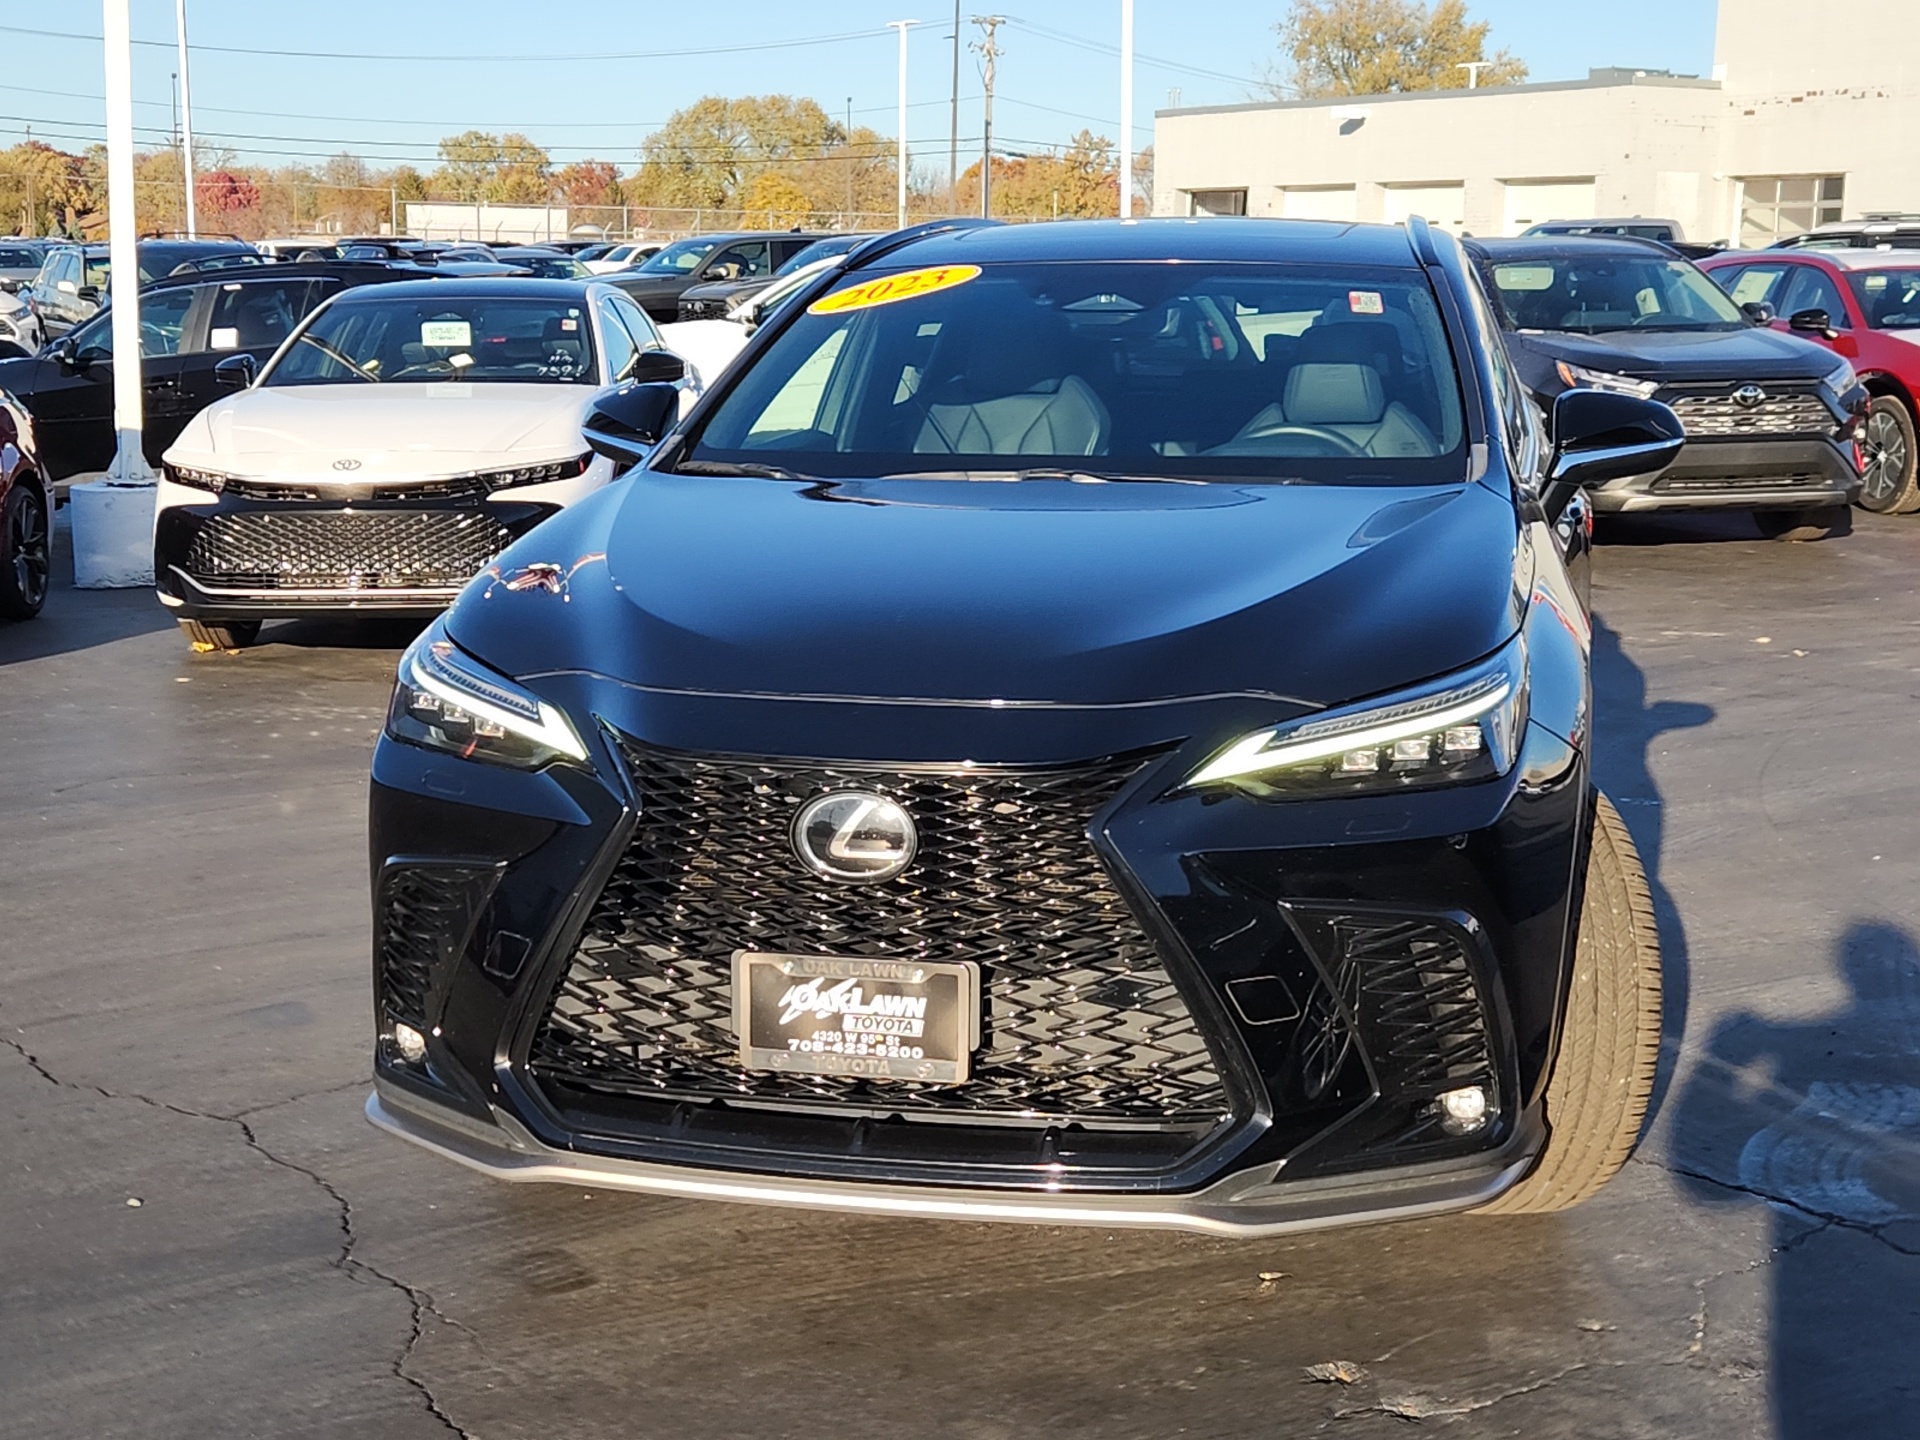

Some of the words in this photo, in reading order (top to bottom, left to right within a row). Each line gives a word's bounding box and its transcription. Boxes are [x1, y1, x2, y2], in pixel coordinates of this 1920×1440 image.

[835, 270, 950, 308] 2023
[805, 960, 842, 975] OAK
[849, 962, 903, 979] LAWN
[853, 1016, 913, 1034] TOYOTA
[812, 1030, 842, 1042] 4320
[844, 1032, 859, 1043] W
[860, 1033, 883, 1044] 95
[885, 1035, 901, 1047] St
[788, 1038, 924, 1059] 708-423-5200
[813, 1056, 891, 1075] TOYOTA
